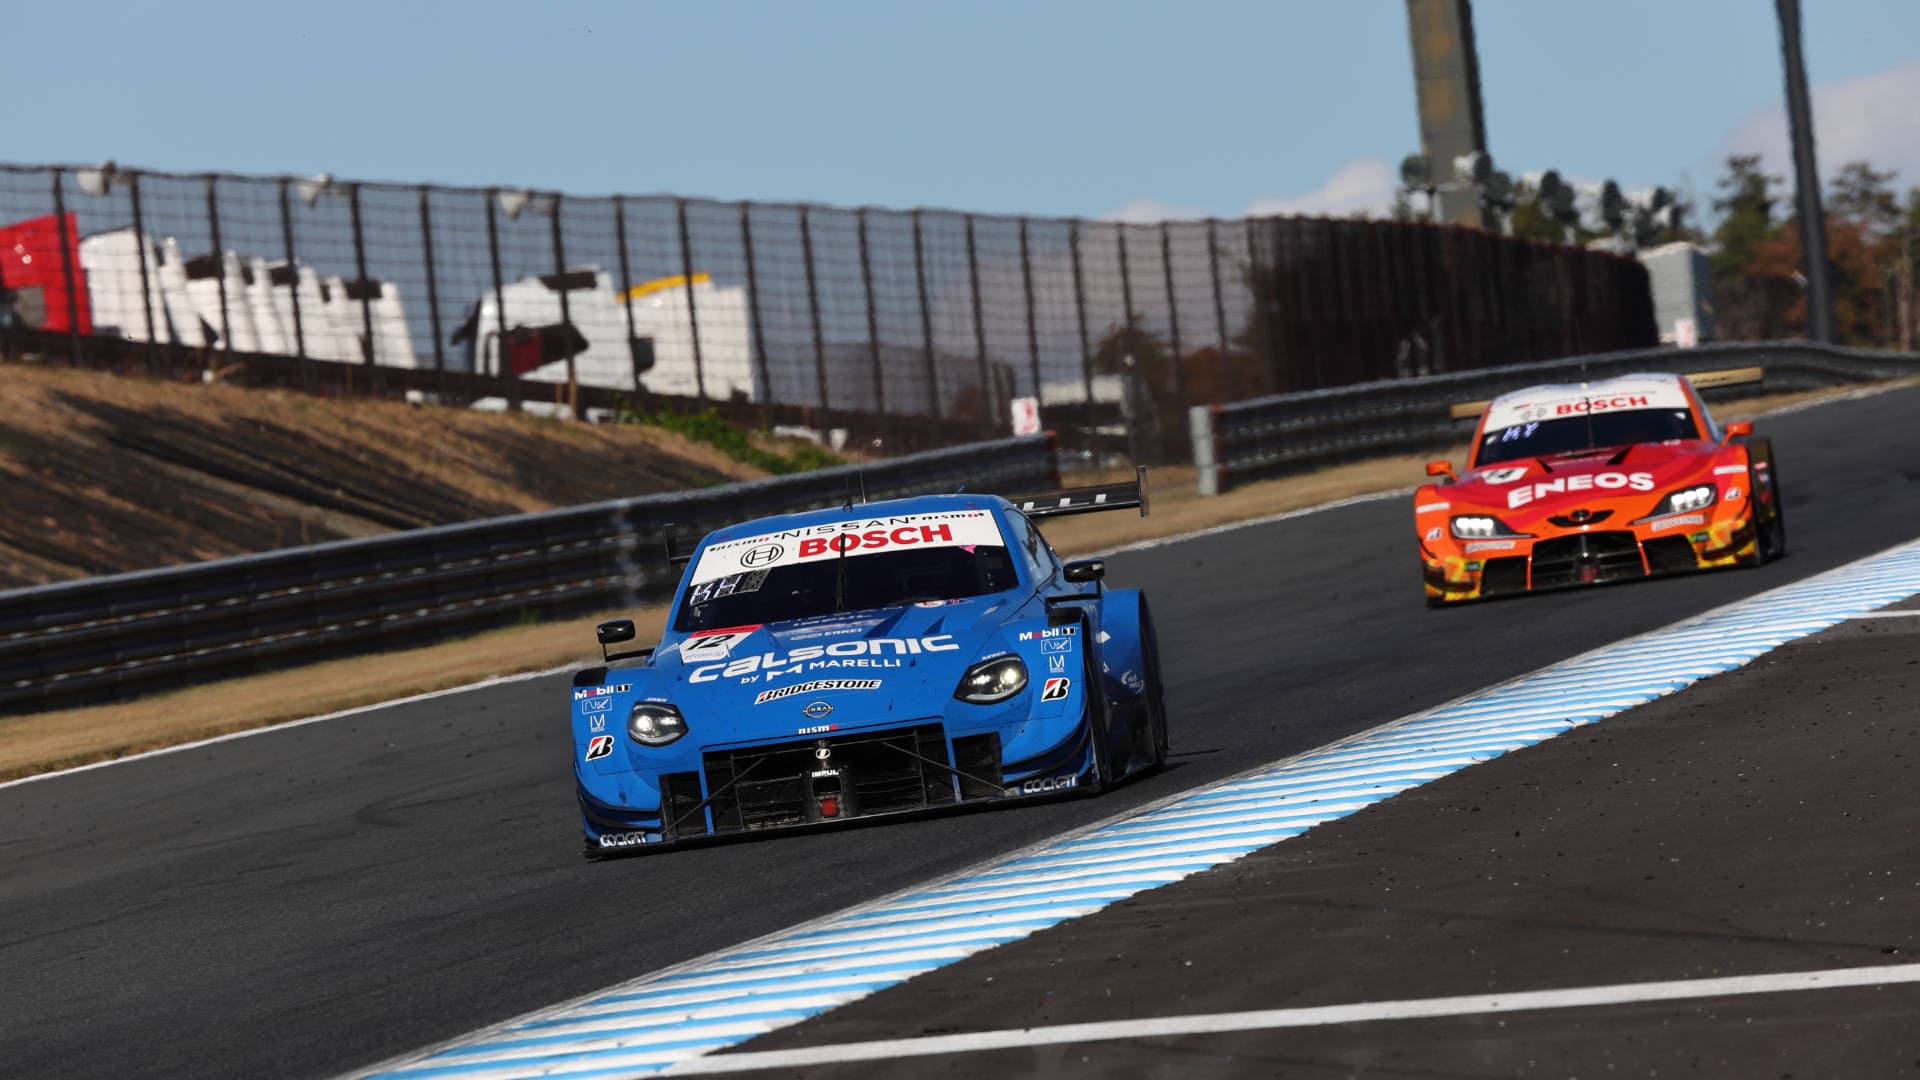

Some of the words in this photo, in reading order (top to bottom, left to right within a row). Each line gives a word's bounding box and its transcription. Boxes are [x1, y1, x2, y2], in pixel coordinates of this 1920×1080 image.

[1556, 396, 1649, 415] BOSCH
[1507, 472, 1655, 510] ENEOS
[781, 516, 910, 541] NISSAN
[799, 523, 953, 559] BOSCH
[685, 634, 737, 652] 12
[1019, 627, 1060, 641] Mobil
[741, 674, 760, 685] by
[809, 657, 901, 671] MARELLI
[574, 685, 615, 700] Mobil
[757, 680, 881, 704] BRIDGESTONE
